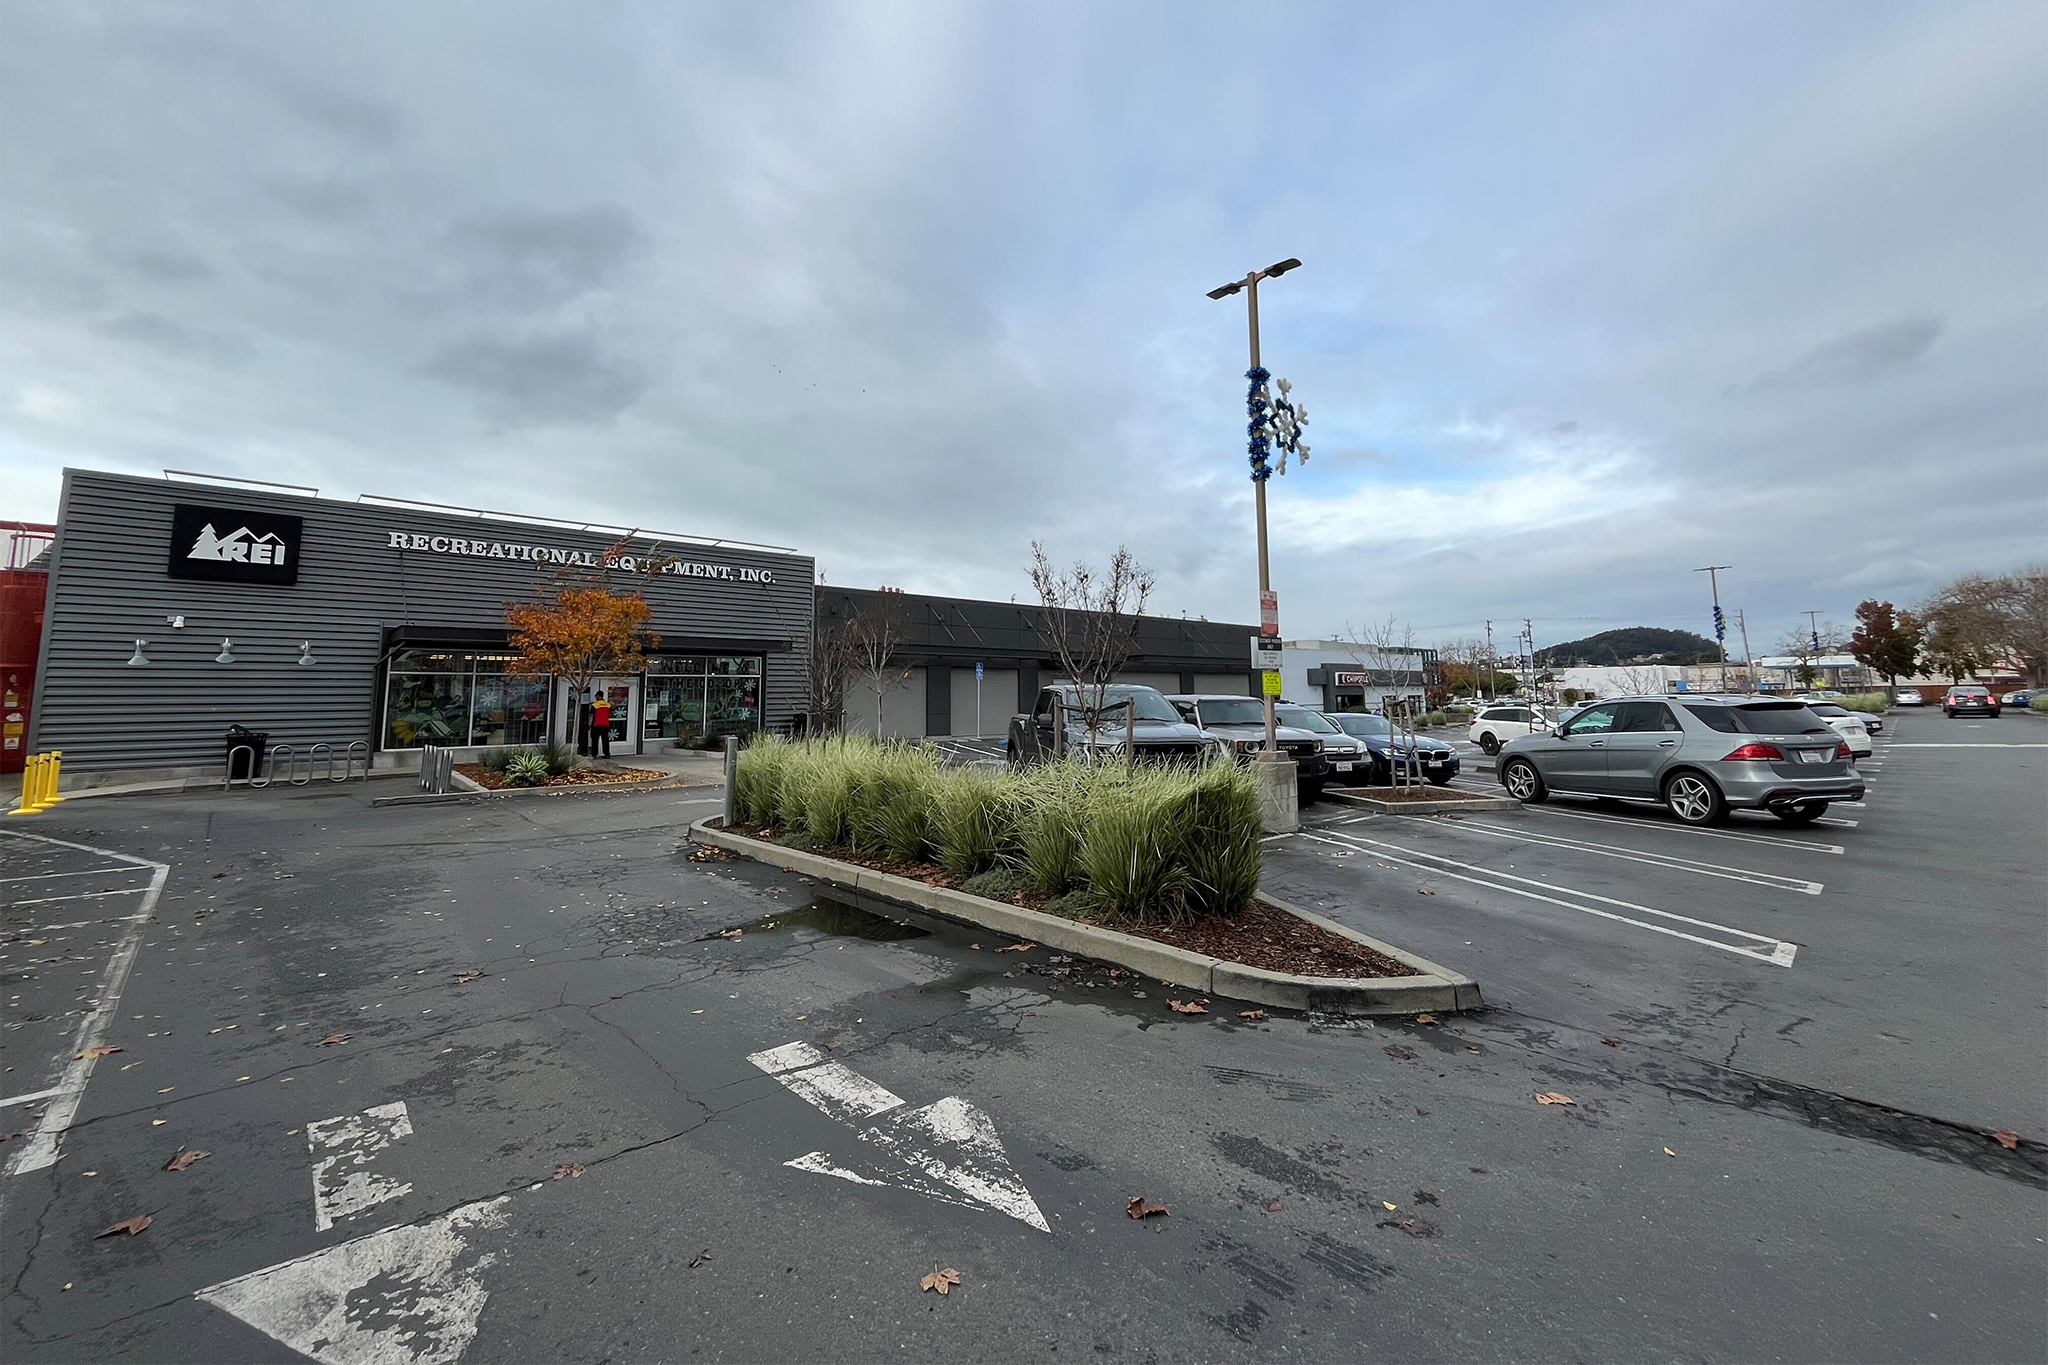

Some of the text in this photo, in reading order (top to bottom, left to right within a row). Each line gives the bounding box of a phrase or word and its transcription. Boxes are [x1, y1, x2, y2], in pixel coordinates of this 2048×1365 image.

[387, 532, 776, 583] RECREATIONAL EQUPMENT, INC.
